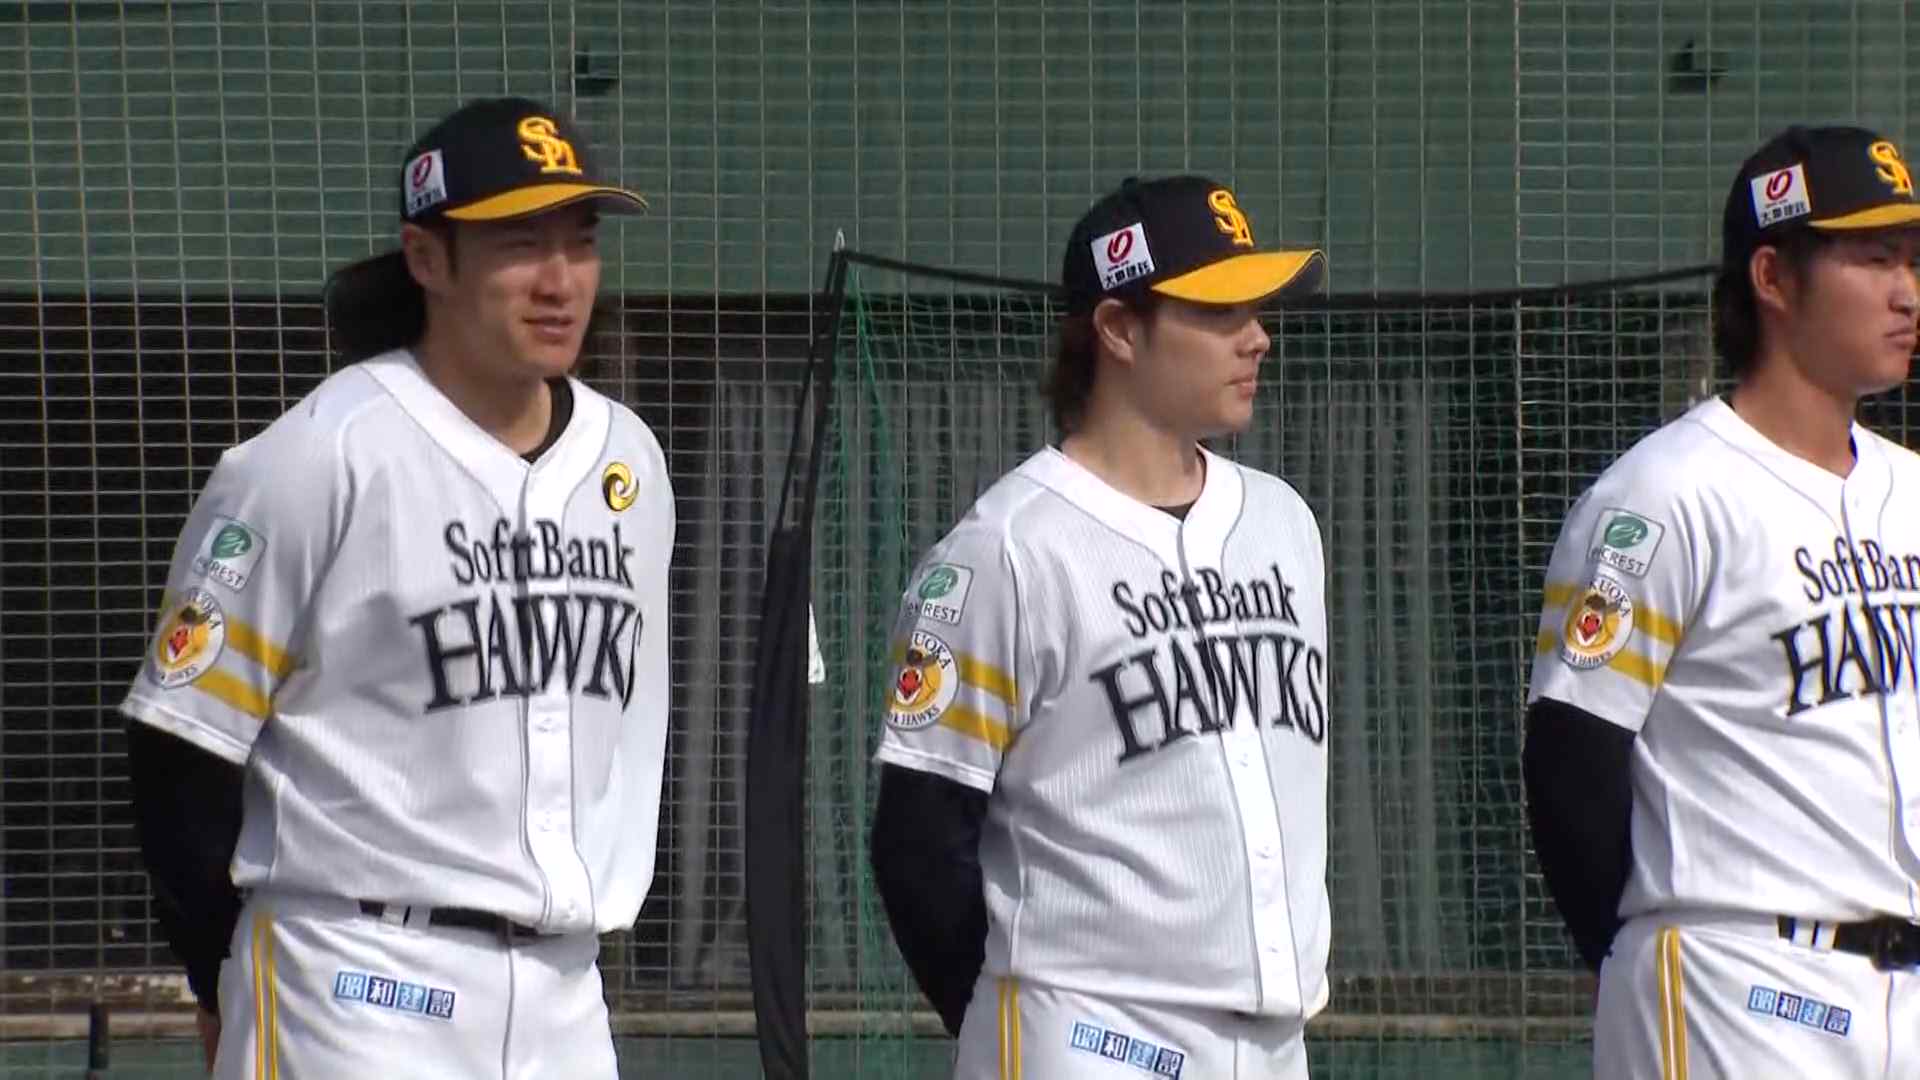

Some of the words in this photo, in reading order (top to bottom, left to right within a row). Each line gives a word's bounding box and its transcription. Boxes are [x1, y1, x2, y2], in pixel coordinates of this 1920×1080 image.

[443, 517, 635, 590] SoftBank
[1794, 535, 1920, 605] SoftBan
[1111, 562, 1300, 639] SoftBank
[1768, 599, 1920, 717] HAW
[1088, 632, 1325, 767] HAWKS
[335, 971, 456, 1019] 昭和建設
